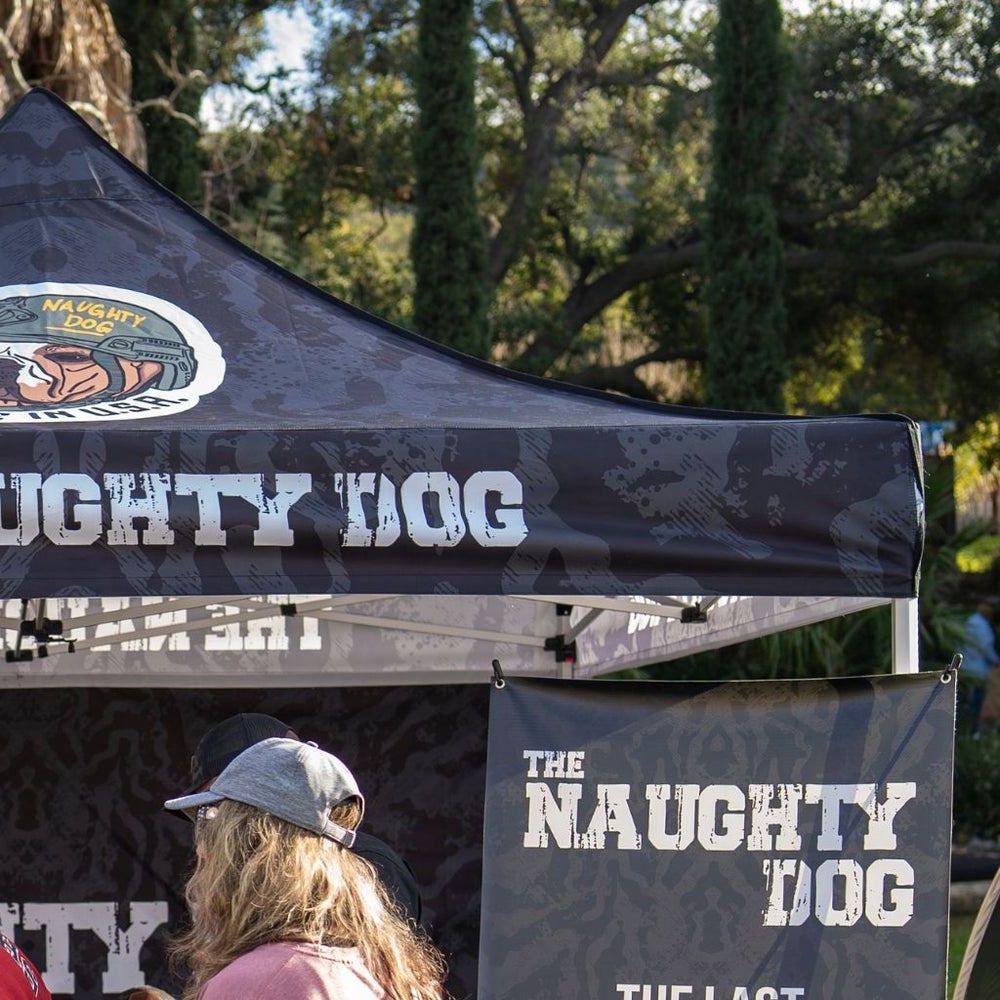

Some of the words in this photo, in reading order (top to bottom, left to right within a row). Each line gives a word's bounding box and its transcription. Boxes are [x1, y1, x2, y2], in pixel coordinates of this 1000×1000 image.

[42, 299, 147, 328] NAUGHTY
[64, 314, 114, 334] DOG
[29, 410, 77, 420] IN
[80, 395, 189, 418] U.S.A.
[334, 471, 529, 548] DOG
[523, 750, 585, 778] THE
[523, 782, 917, 851] NAUGHTY
[761, 858, 915, 927] DOG
